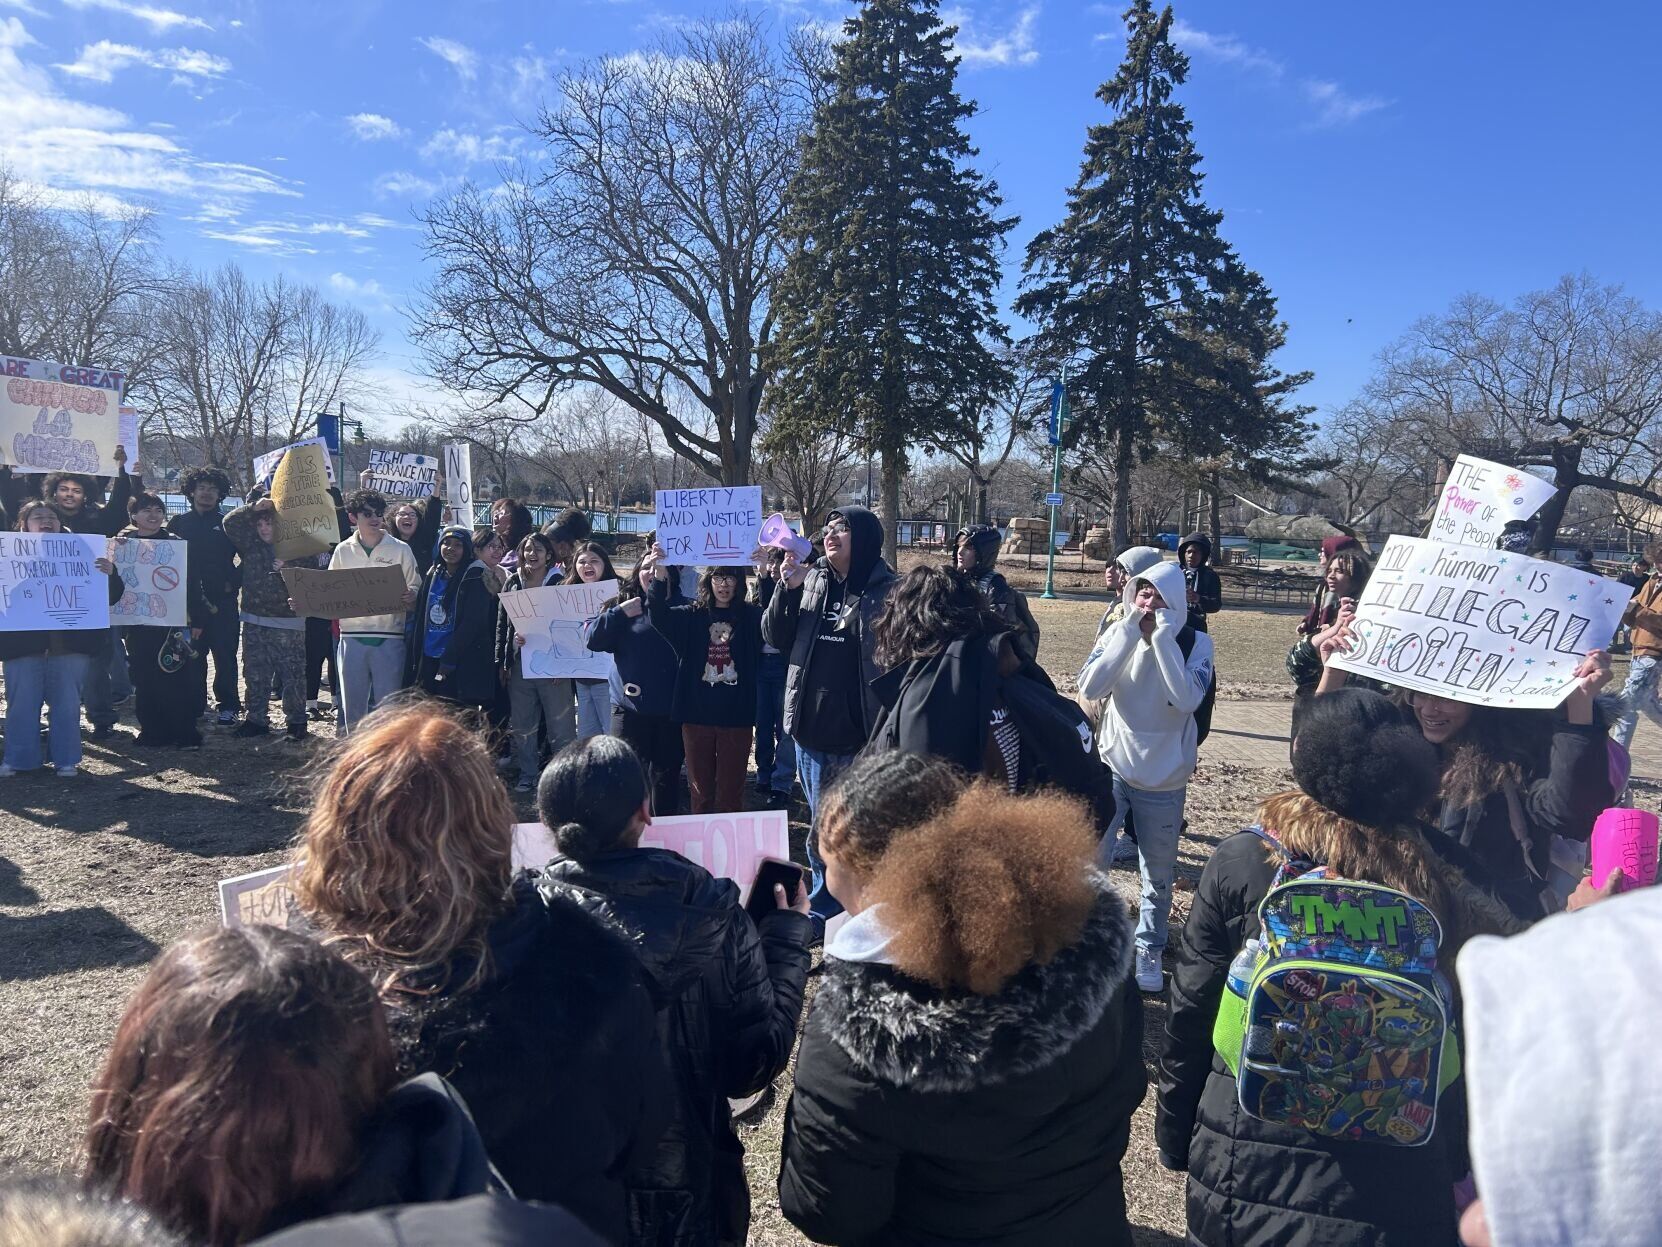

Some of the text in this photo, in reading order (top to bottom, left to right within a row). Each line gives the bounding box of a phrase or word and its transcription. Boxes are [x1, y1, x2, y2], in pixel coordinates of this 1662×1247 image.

[60, 366, 124, 391] GREAT
[371, 450, 408, 465] FIGHT
[1456, 460, 1492, 491] THE
[662, 488, 734, 509] LIBERTY
[659, 509, 756, 529] AND JUSTICE
[1436, 509, 1456, 535] the
[13, 537, 37, 557] ONLY
[41, 539, 81, 558] THING
[666, 530, 740, 558] FOR ALL
[10, 559, 60, 580] POWERFUL
[63, 561, 91, 578] THAN
[1429, 547, 1500, 585] human
[1527, 570, 1551, 593] IS
[23, 589, 33, 599] IS
[500, 591, 545, 619] ICE
[1364, 581, 1592, 657] ILLEGAL
[819, 634, 846, 644] ARMOUR
[1339, 618, 1579, 697] STOLEN Land
[1291, 895, 1407, 946] TMNT
[1286, 974, 1317, 998] STOP
